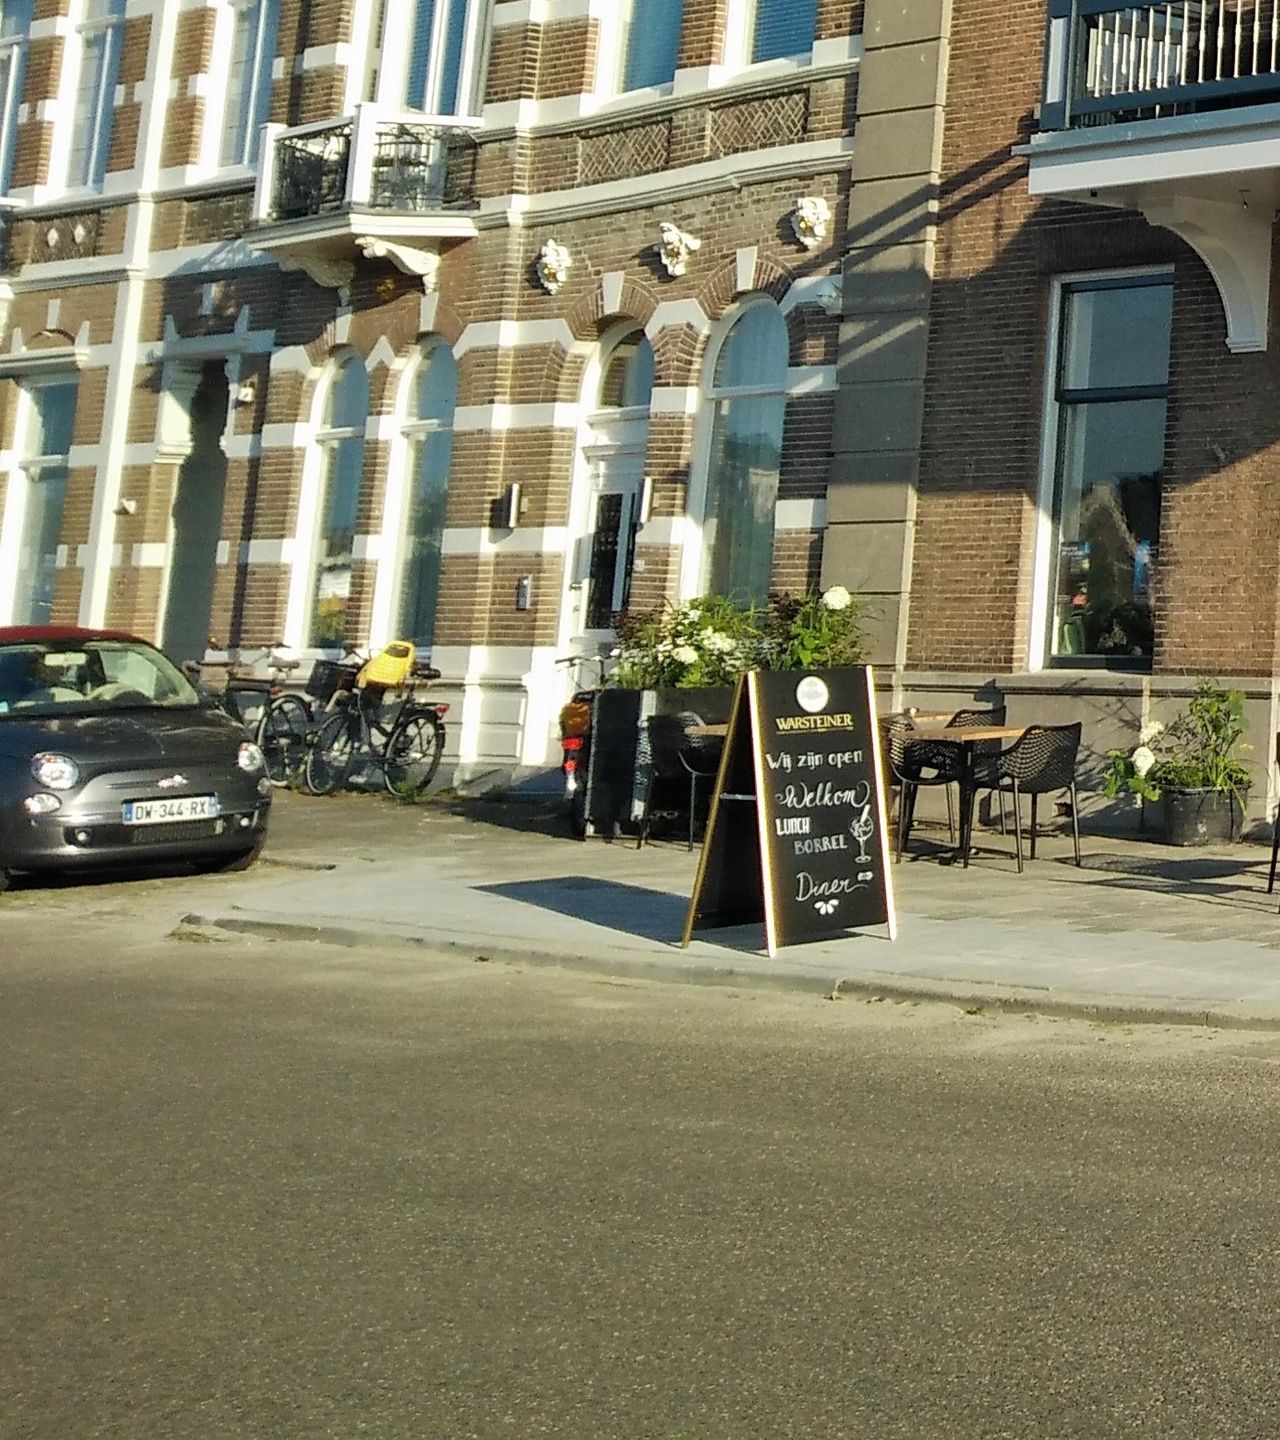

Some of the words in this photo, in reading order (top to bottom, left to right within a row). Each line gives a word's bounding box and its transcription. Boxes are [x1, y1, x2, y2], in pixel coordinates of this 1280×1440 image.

[776, 714, 853, 731] WARSTEINER
[767, 752, 791, 773] Wij
[798, 752, 823, 770] zijn
[828, 750, 862, 768] open
[776, 780, 870, 808] Welkom
[136, 799, 206, 819] DW-344-RX
[775, 817, 810, 836] LUNCH
[794, 835, 848, 855] BORREL
[795, 872, 866, 901] Diner
